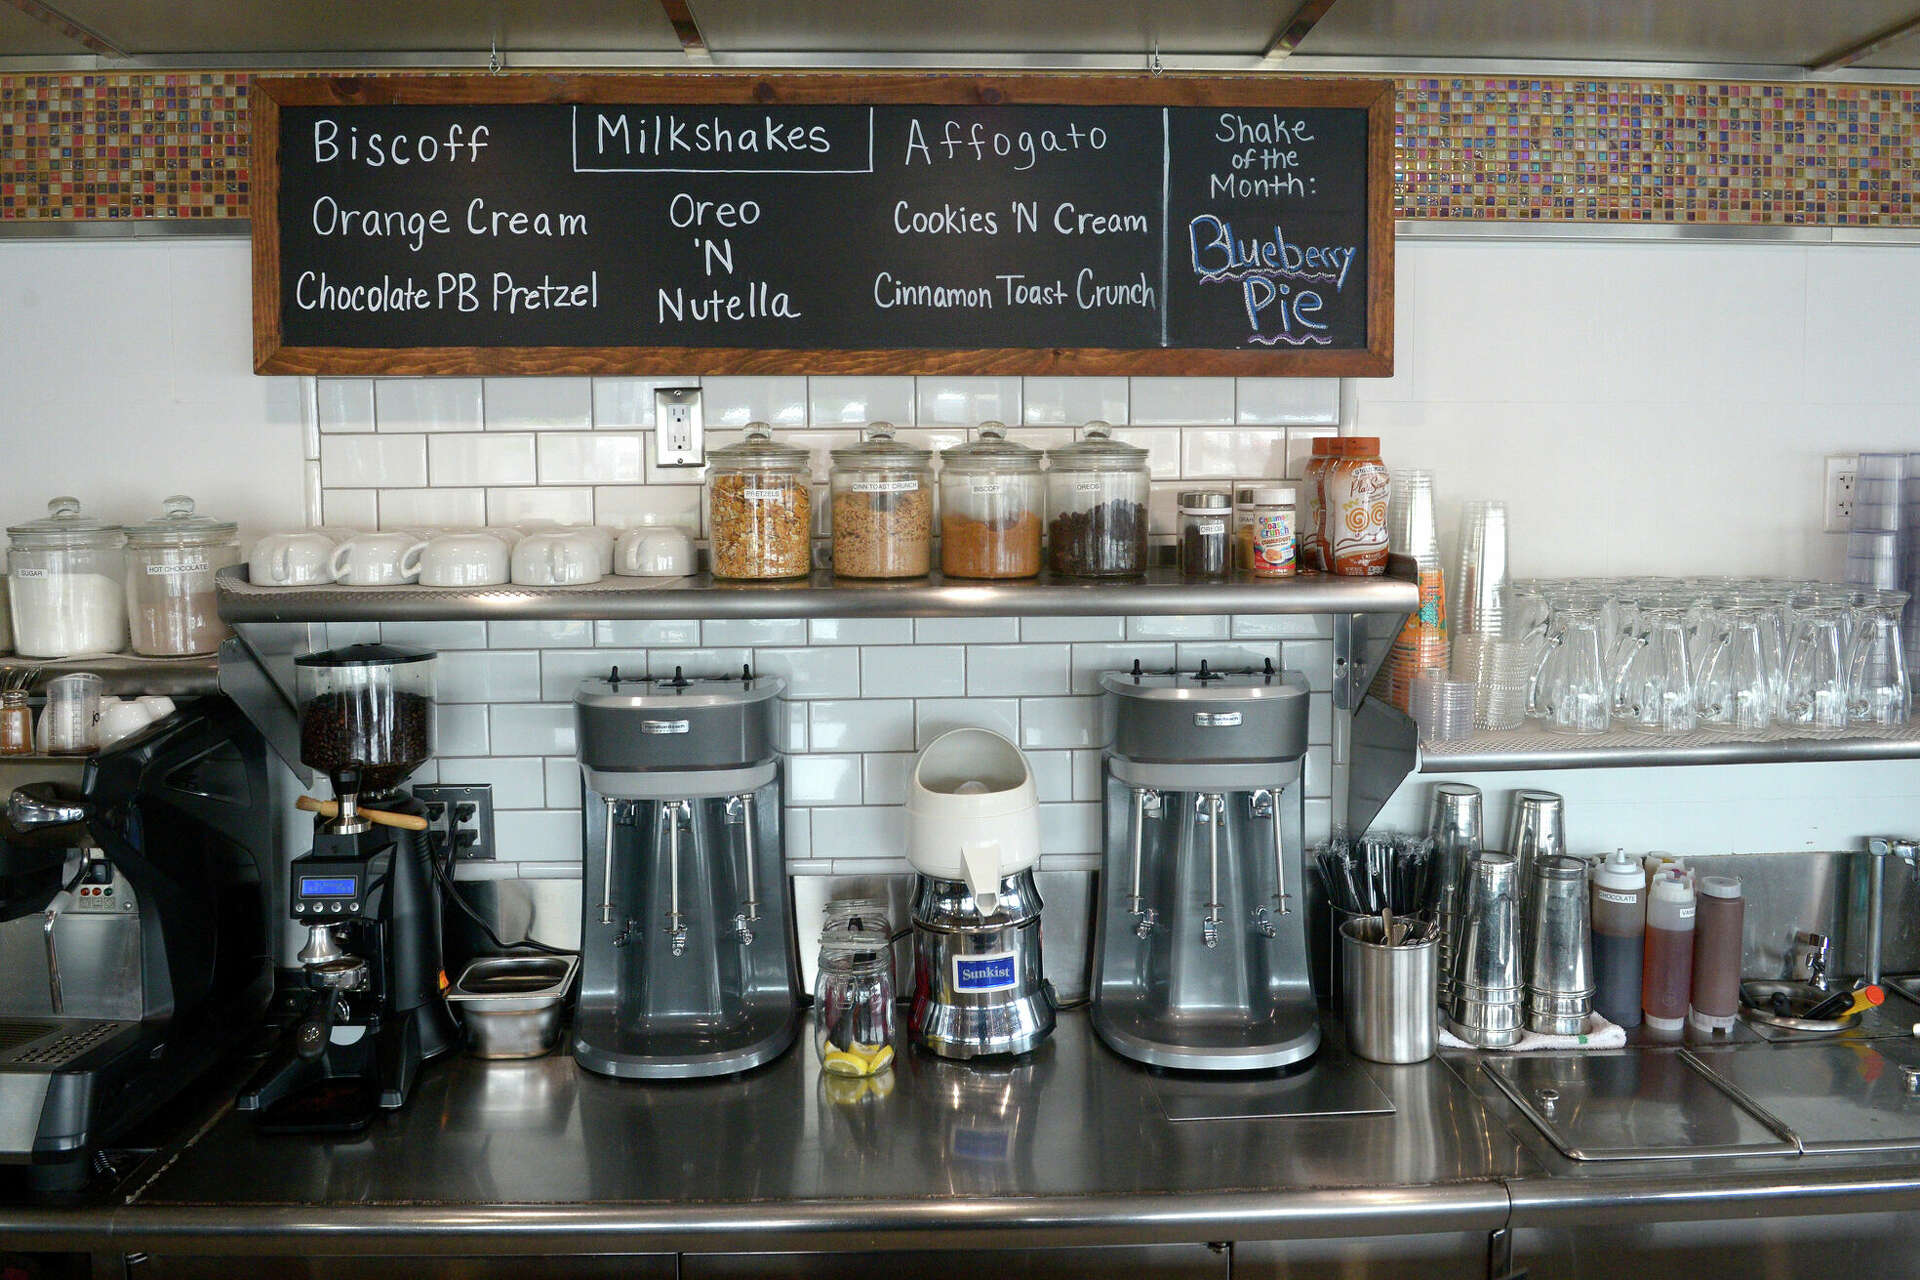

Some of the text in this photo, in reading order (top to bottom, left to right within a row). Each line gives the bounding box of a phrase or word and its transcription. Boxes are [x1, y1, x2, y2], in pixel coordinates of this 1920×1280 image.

[315, 120, 489, 166] Biscoff
[598, 114, 830, 155] Milkshakes
[905, 119, 1106, 170] Affogato
[1216, 113, 1314, 144] Shake
[1232, 148, 1298, 170] of the
[1211, 173, 1315, 199] Month:
[314, 196, 587, 251] Orange Cream
[670, 194, 760, 227] Oreo
[895, 201, 997, 234] Cookies
[1054, 203, 1147, 234] Cream
[1189, 214, 1357, 292] Blueberry
[297, 271, 597, 314] Chocolate PB Pretzel
[659, 282, 801, 323] Nutella
[875, 268, 1155, 309] Cinnamon Toast Crunch
[1243, 276, 1328, 330] Pie
[745, 490, 781, 498] PRETZELS
[20, 569, 43, 578] SUGAR
[148, 563, 209, 574] HOT CHOCOLATE
[1599, 892, 1635, 902] CHOCOLATE
[962, 965, 1010, 982] Sunkist
